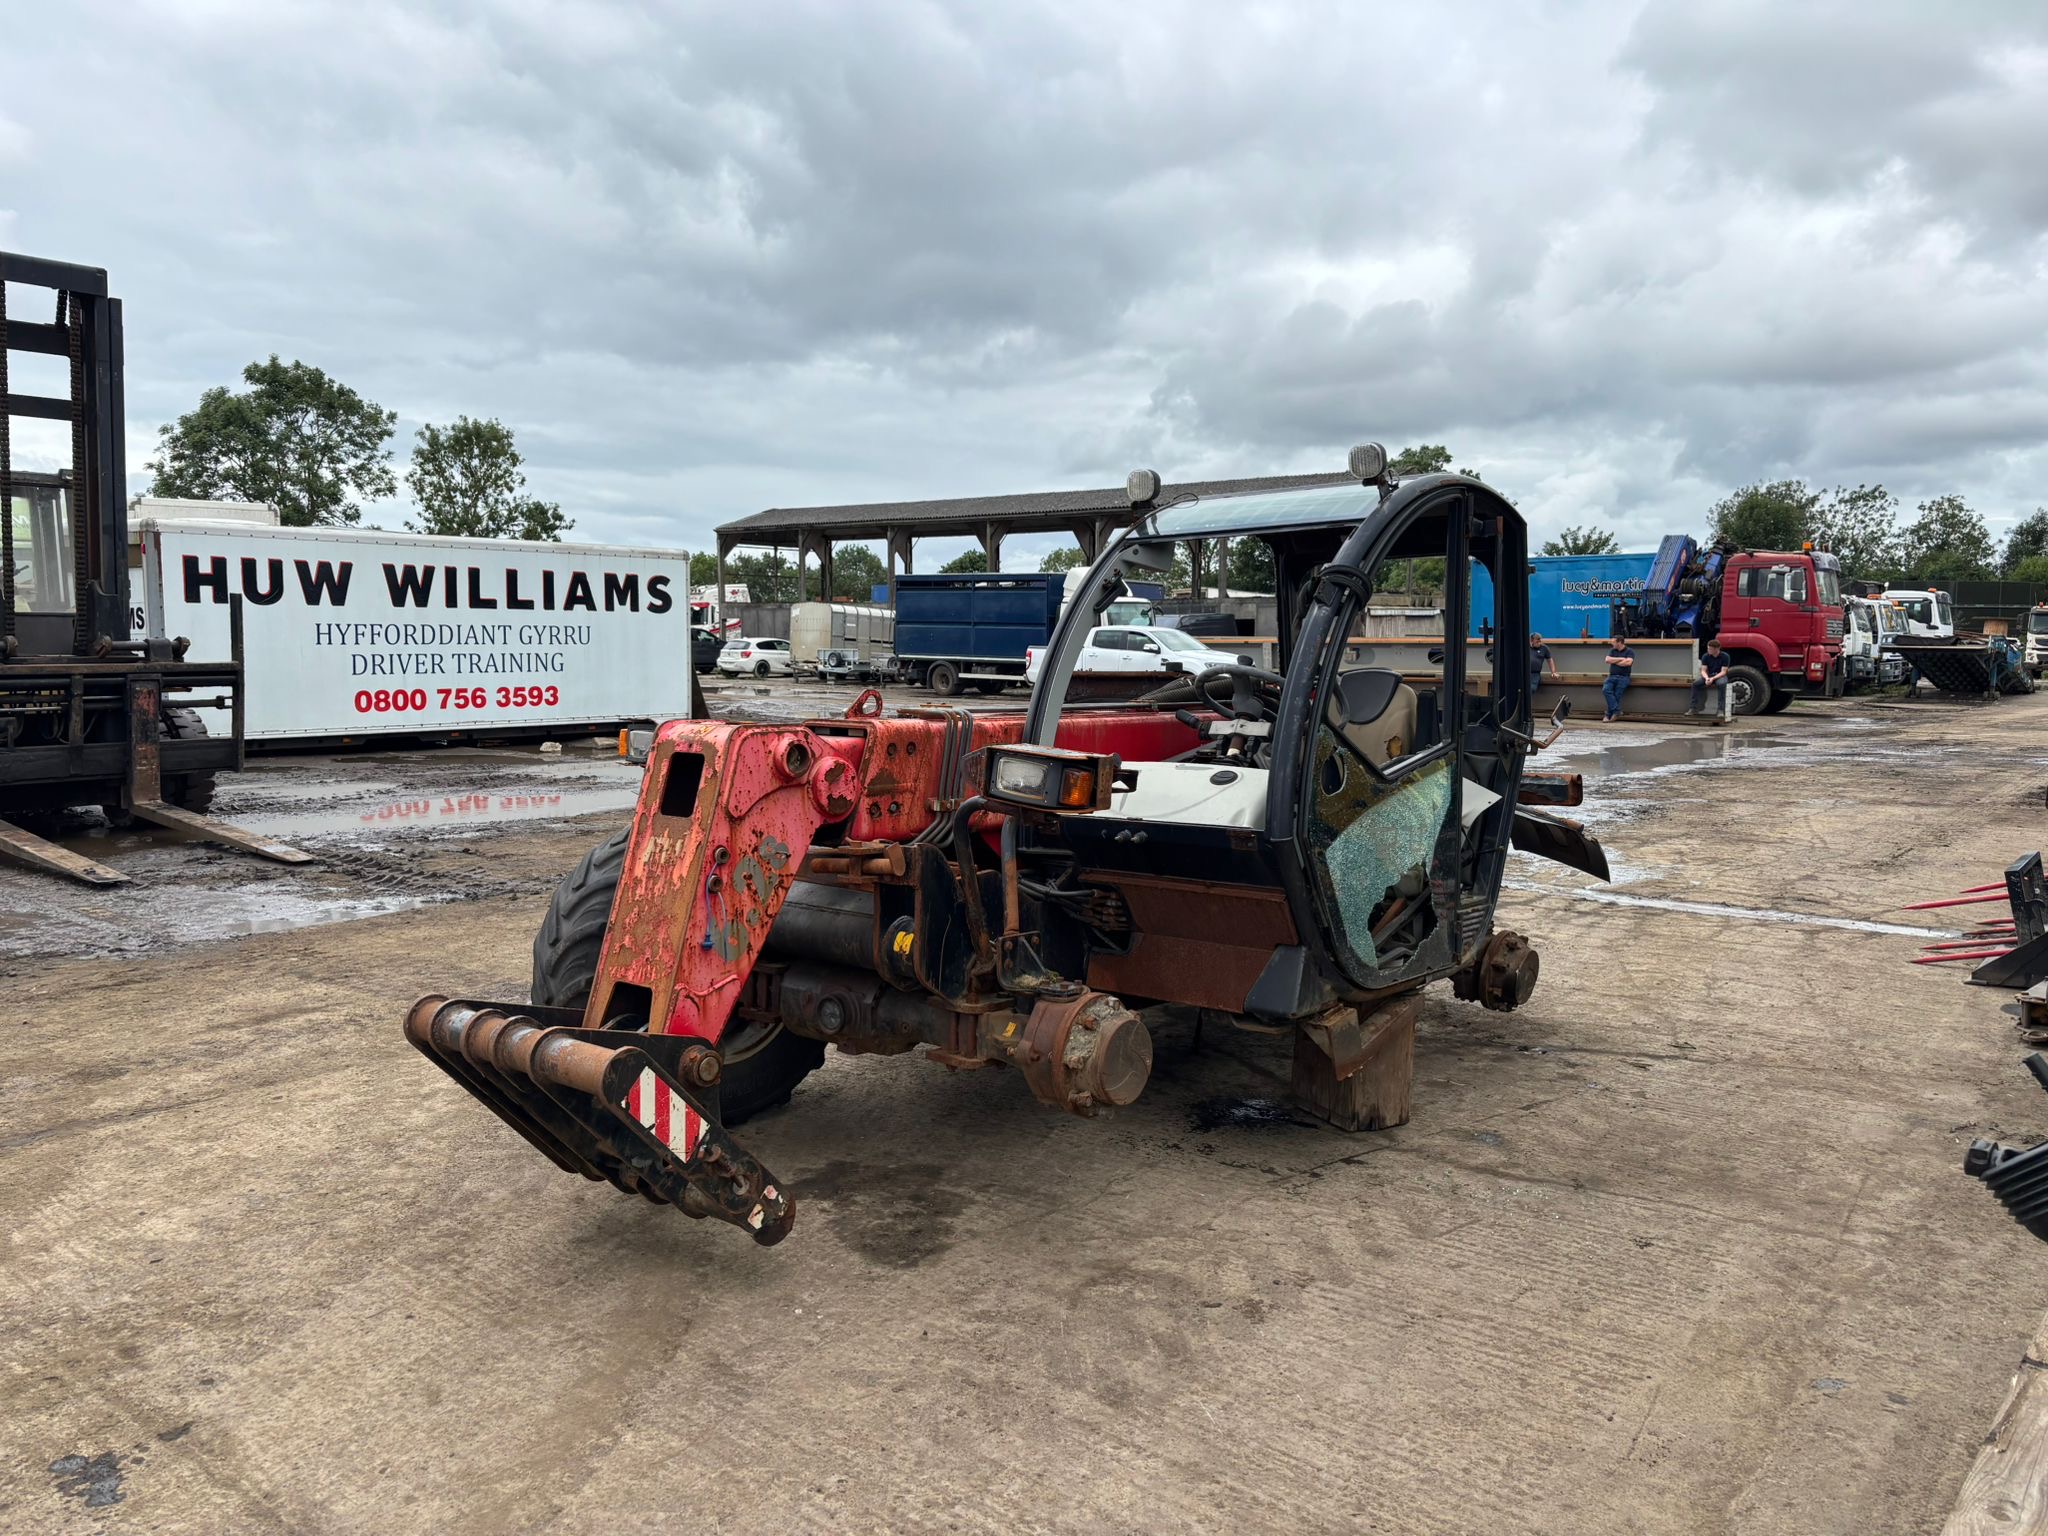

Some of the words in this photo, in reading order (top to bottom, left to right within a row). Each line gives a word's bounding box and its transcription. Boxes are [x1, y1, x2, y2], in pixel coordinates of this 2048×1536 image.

[182, 554, 353, 606] HUW
[381, 563, 673, 614] WILLIAMS
[315, 623, 512, 645] HYFFORDDIANT
[519, 624, 592, 646] GYRRU
[351, 653, 446, 676] DRIVER
[451, 652, 565, 674] TRAINING
[354, 688, 427, 713] 0800
[436, 687, 487, 710] 756
[495, 685, 560, 708] 3593
